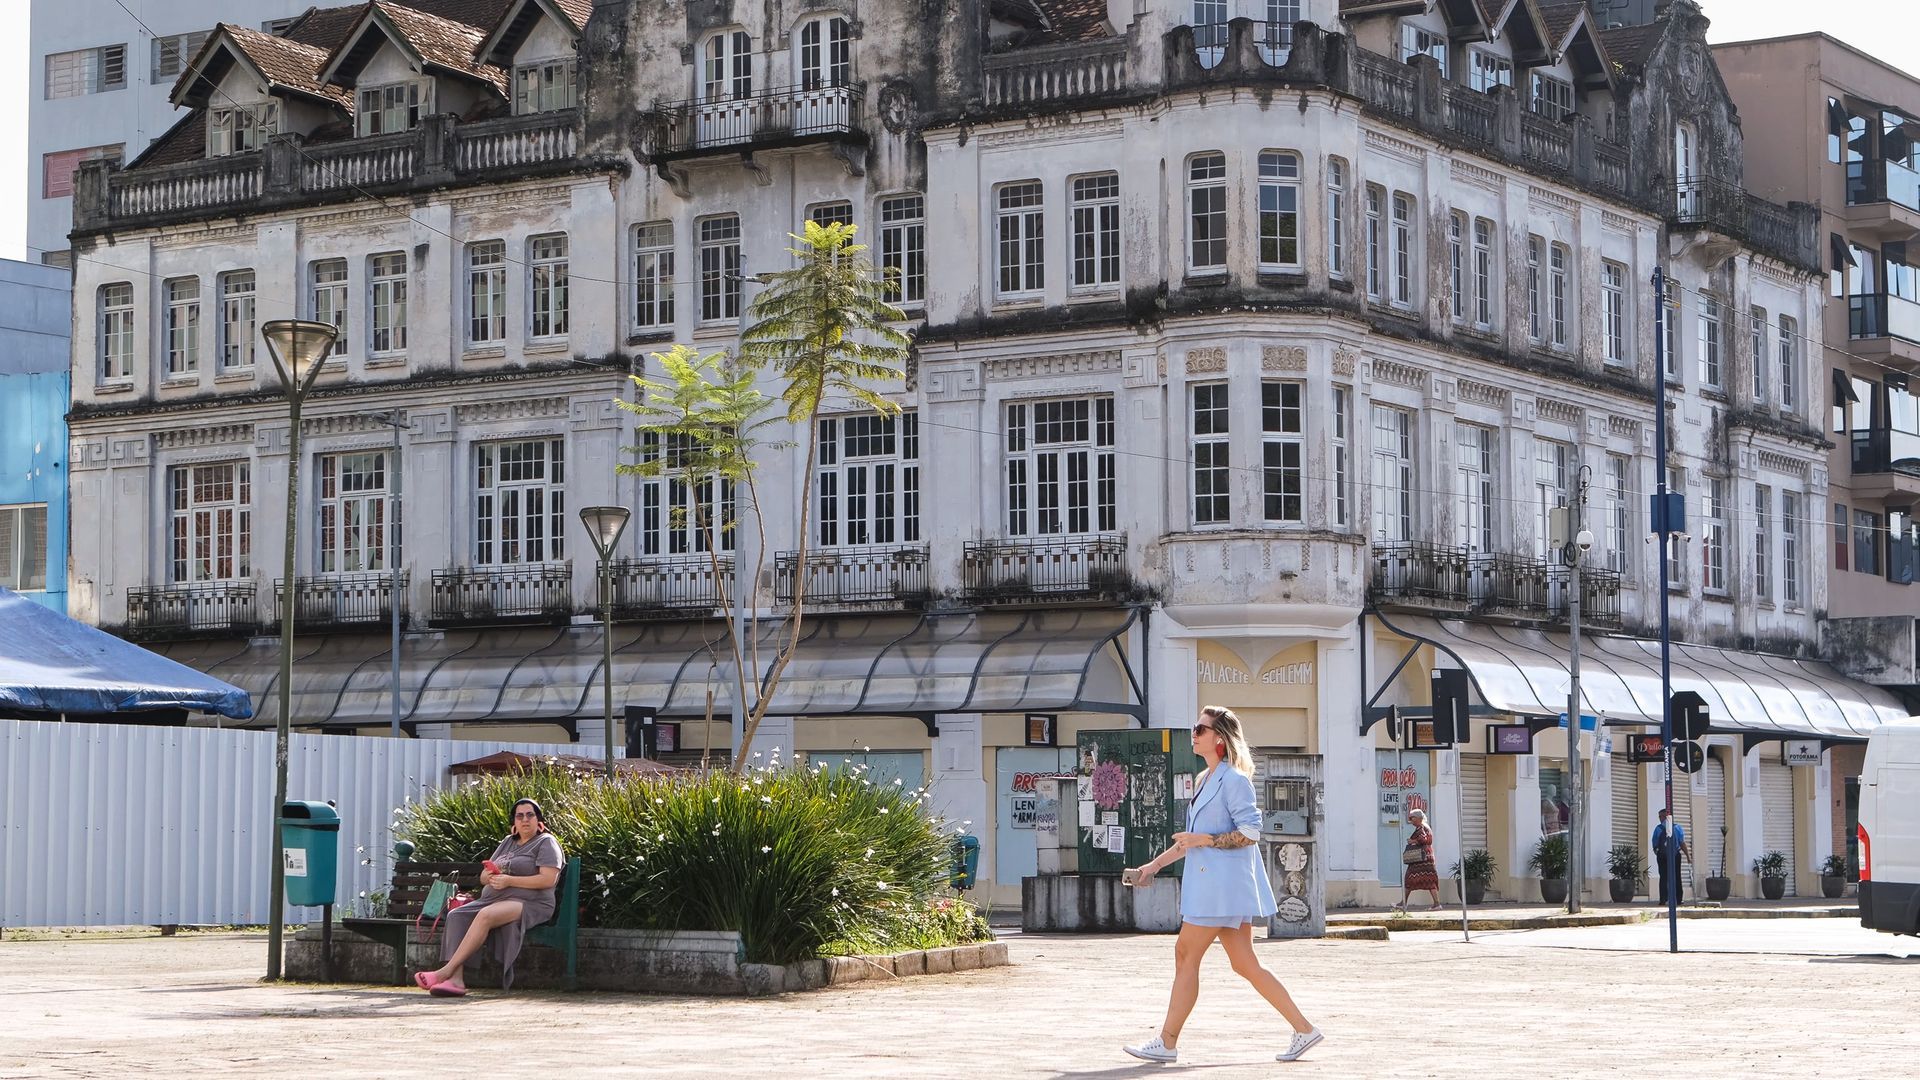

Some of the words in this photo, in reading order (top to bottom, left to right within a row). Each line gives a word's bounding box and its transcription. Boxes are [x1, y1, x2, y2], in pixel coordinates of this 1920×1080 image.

[1197, 660, 1249, 684] PALACETE
[1261, 662, 1313, 685] SCHLEMM
[1015, 800, 1035, 811] LEN
